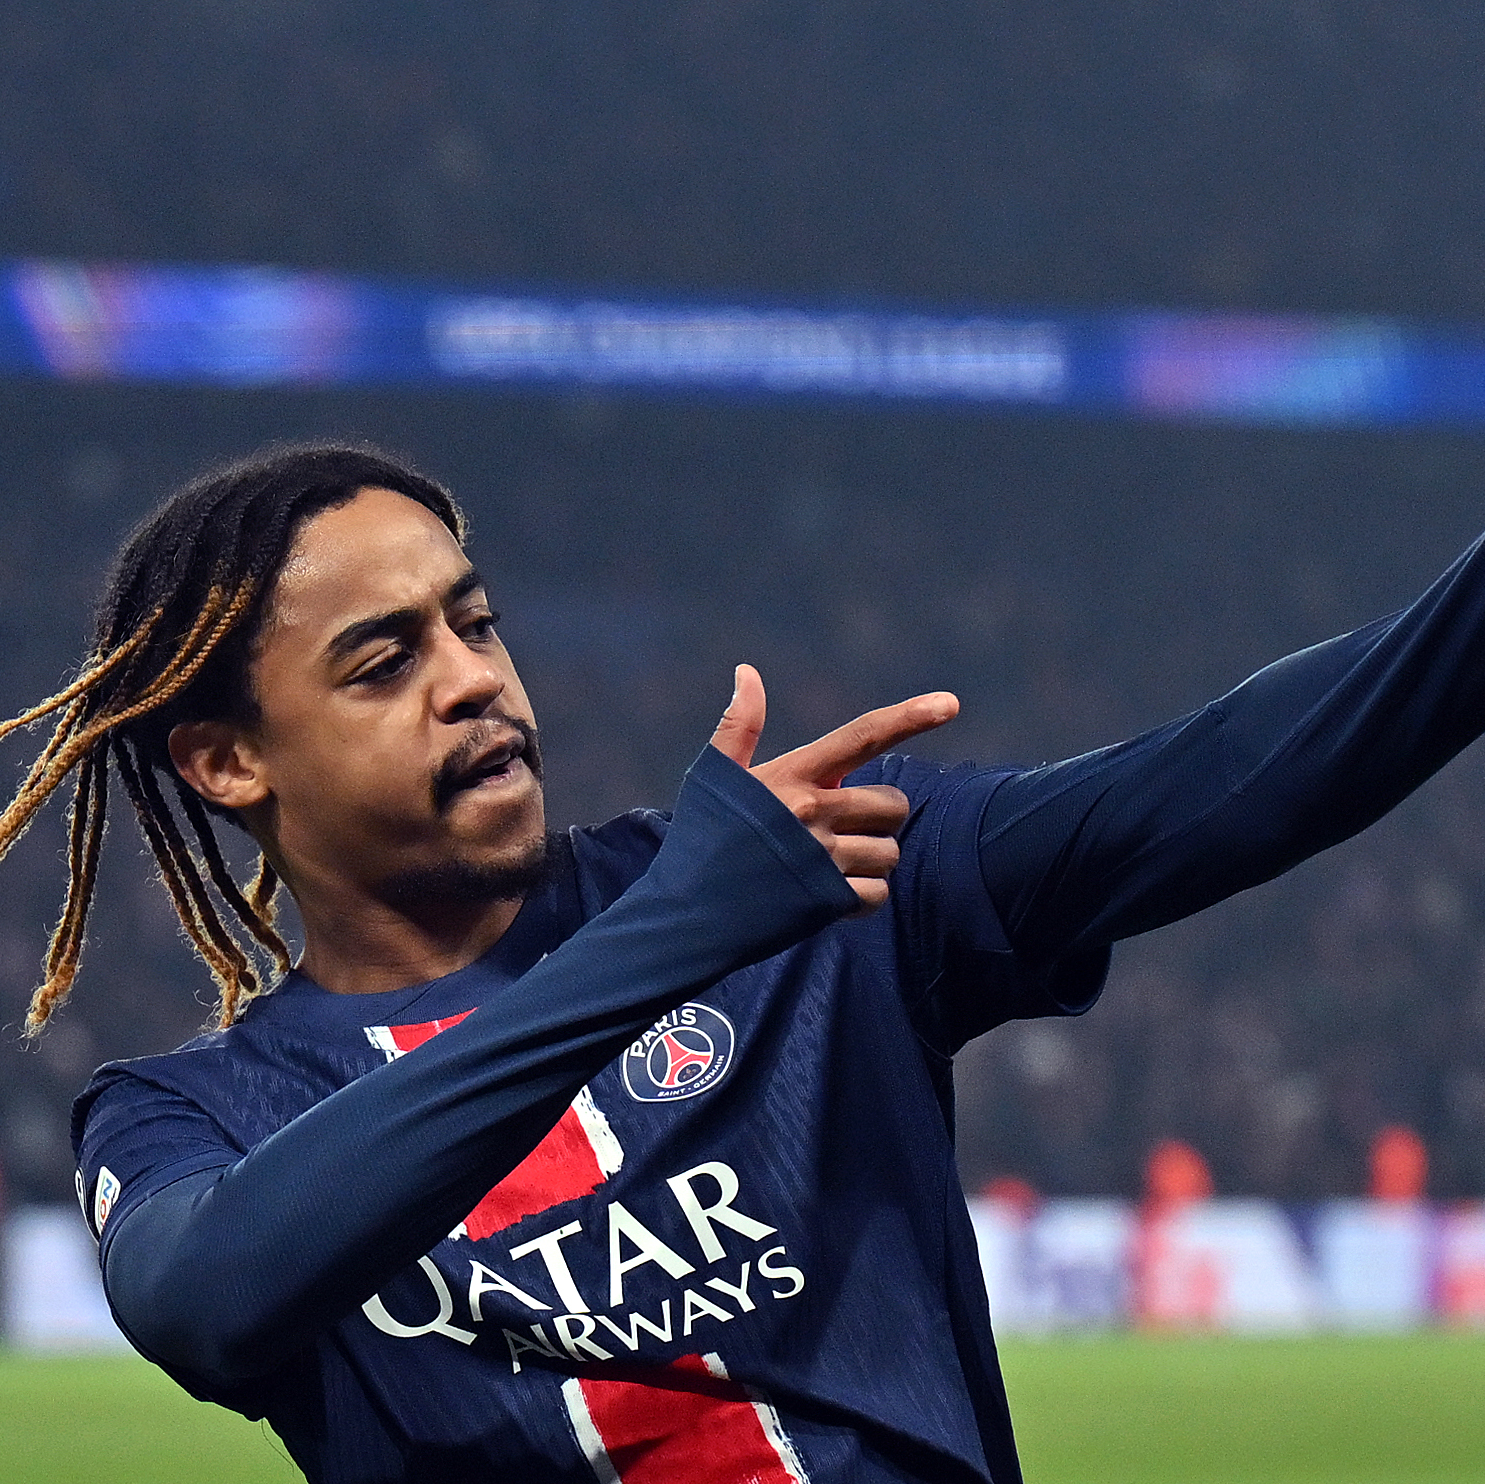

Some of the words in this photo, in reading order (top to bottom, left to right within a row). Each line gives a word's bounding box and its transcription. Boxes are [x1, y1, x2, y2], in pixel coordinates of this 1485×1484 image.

[630, 1008, 697, 1058] PARIS
[361, 1161, 778, 1346] QATAR
[501, 1245, 806, 1375] AIRWAYS
